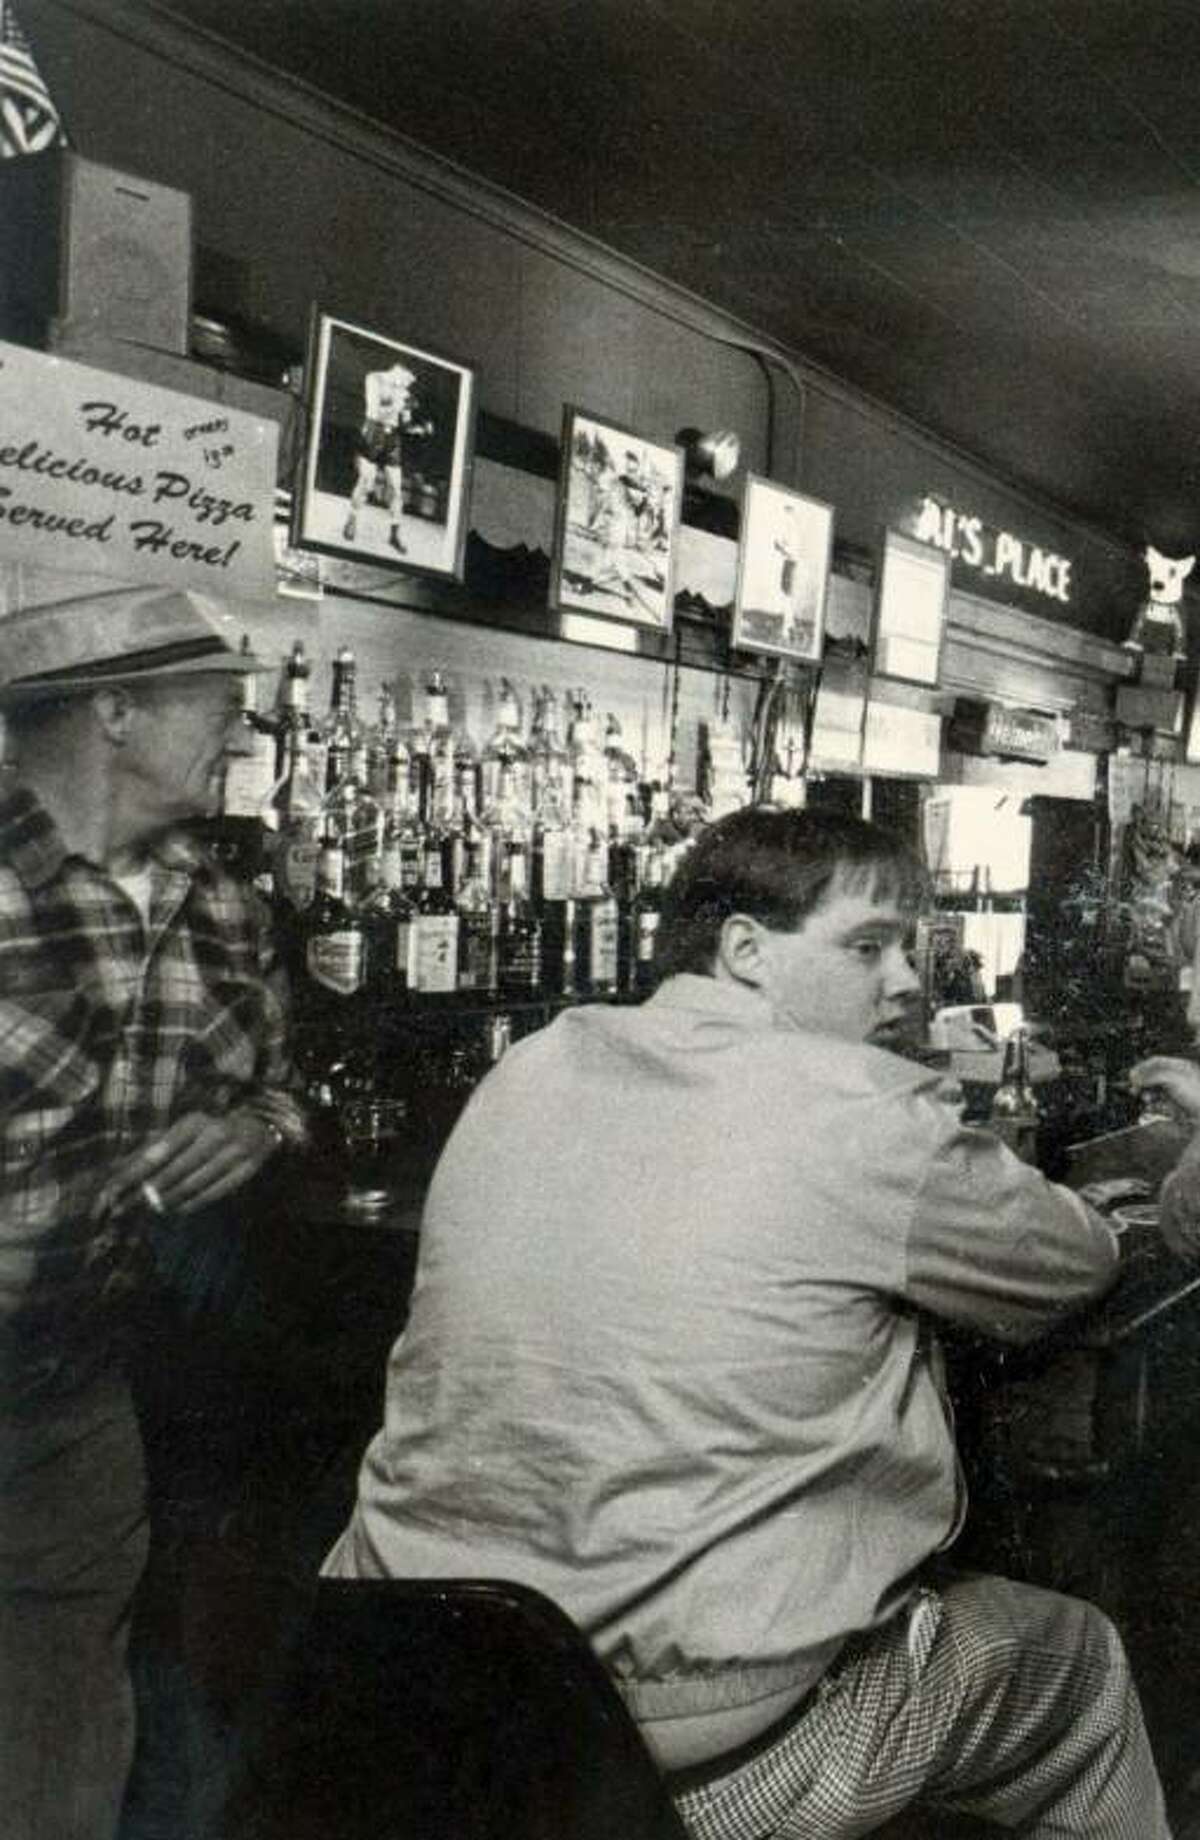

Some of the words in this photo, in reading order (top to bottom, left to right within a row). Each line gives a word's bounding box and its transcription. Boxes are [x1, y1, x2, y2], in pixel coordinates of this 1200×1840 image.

[79, 402, 161, 446] Hot
[151, 471, 255, 525] Pizza
[130, 521, 241, 567] Here!
[995, 531, 1072, 602] PLACE
